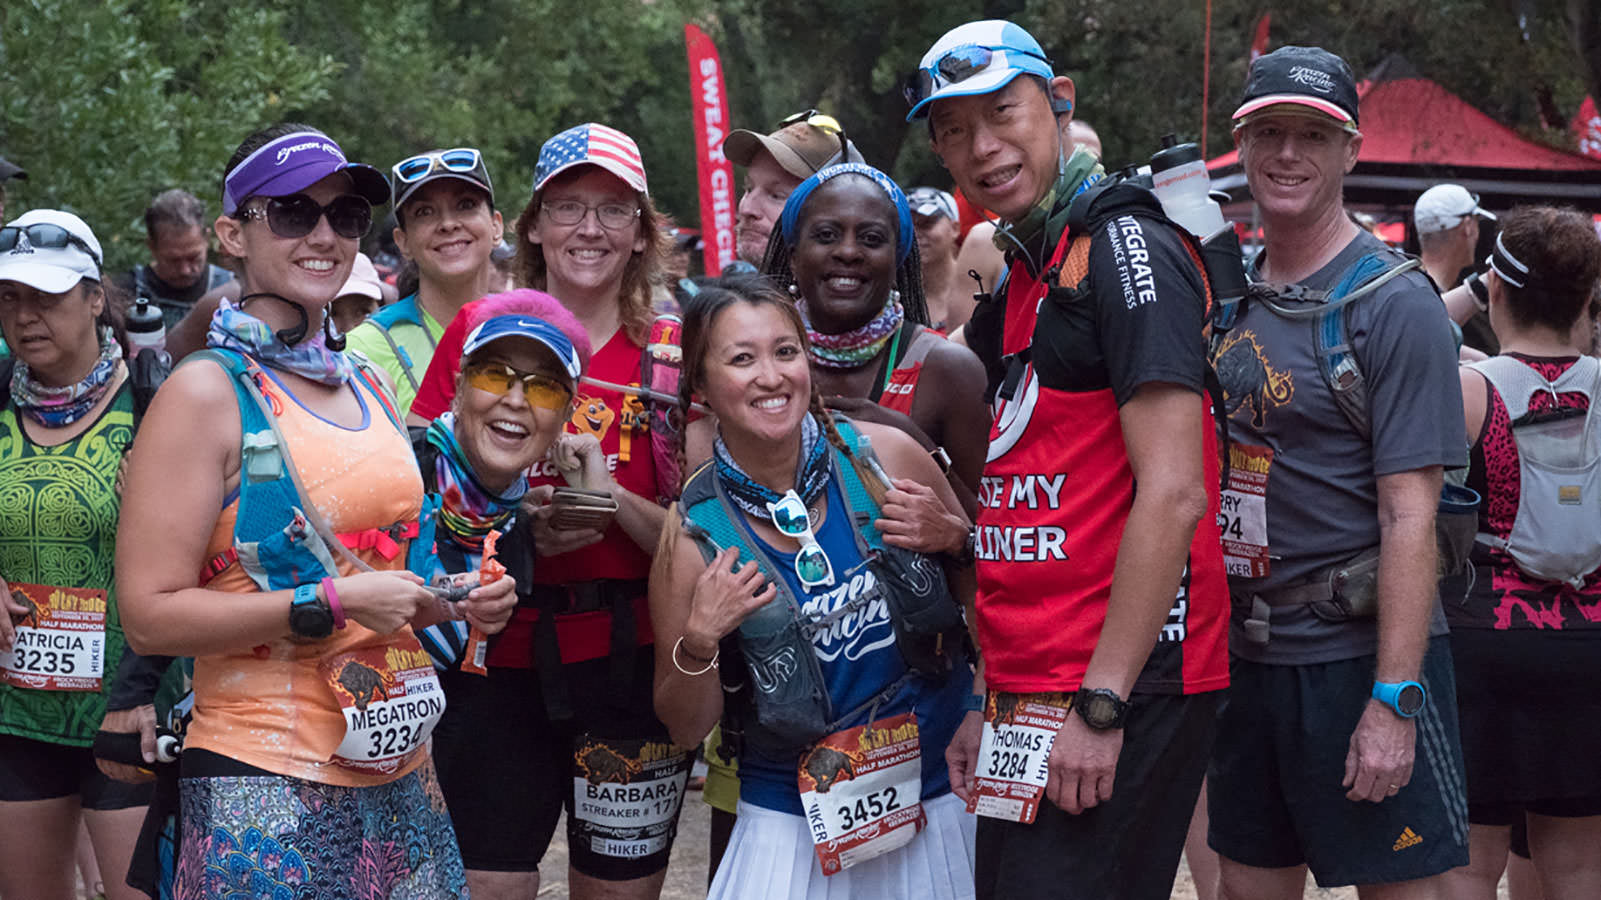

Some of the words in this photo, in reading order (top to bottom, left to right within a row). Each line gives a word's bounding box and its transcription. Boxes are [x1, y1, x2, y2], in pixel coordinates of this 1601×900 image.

[700, 58, 726, 164] SWEAT
[1118, 266, 1137, 309] FITNESS
[1008, 474, 1067, 509] MY
[60, 621, 105, 631] MARATHON
[16, 631, 84, 651] ATRICIA
[13, 648, 76, 674] 3235
[91, 639, 100, 672] HIKER
[406, 682, 435, 696] HIKER
[351, 696, 442, 731] MEGATRON
[367, 721, 425, 758] 3234
[991, 729, 1043, 752] THOMAS
[855, 762, 877, 775] HALF
[877, 749, 921, 768] MARATHON
[988, 750, 1030, 780] 3284
[586, 780, 678, 803] BARBARA
[581, 802, 640, 818] STREAKER
[837, 786, 901, 831] 3452
[607, 842, 649, 856] HIKER
